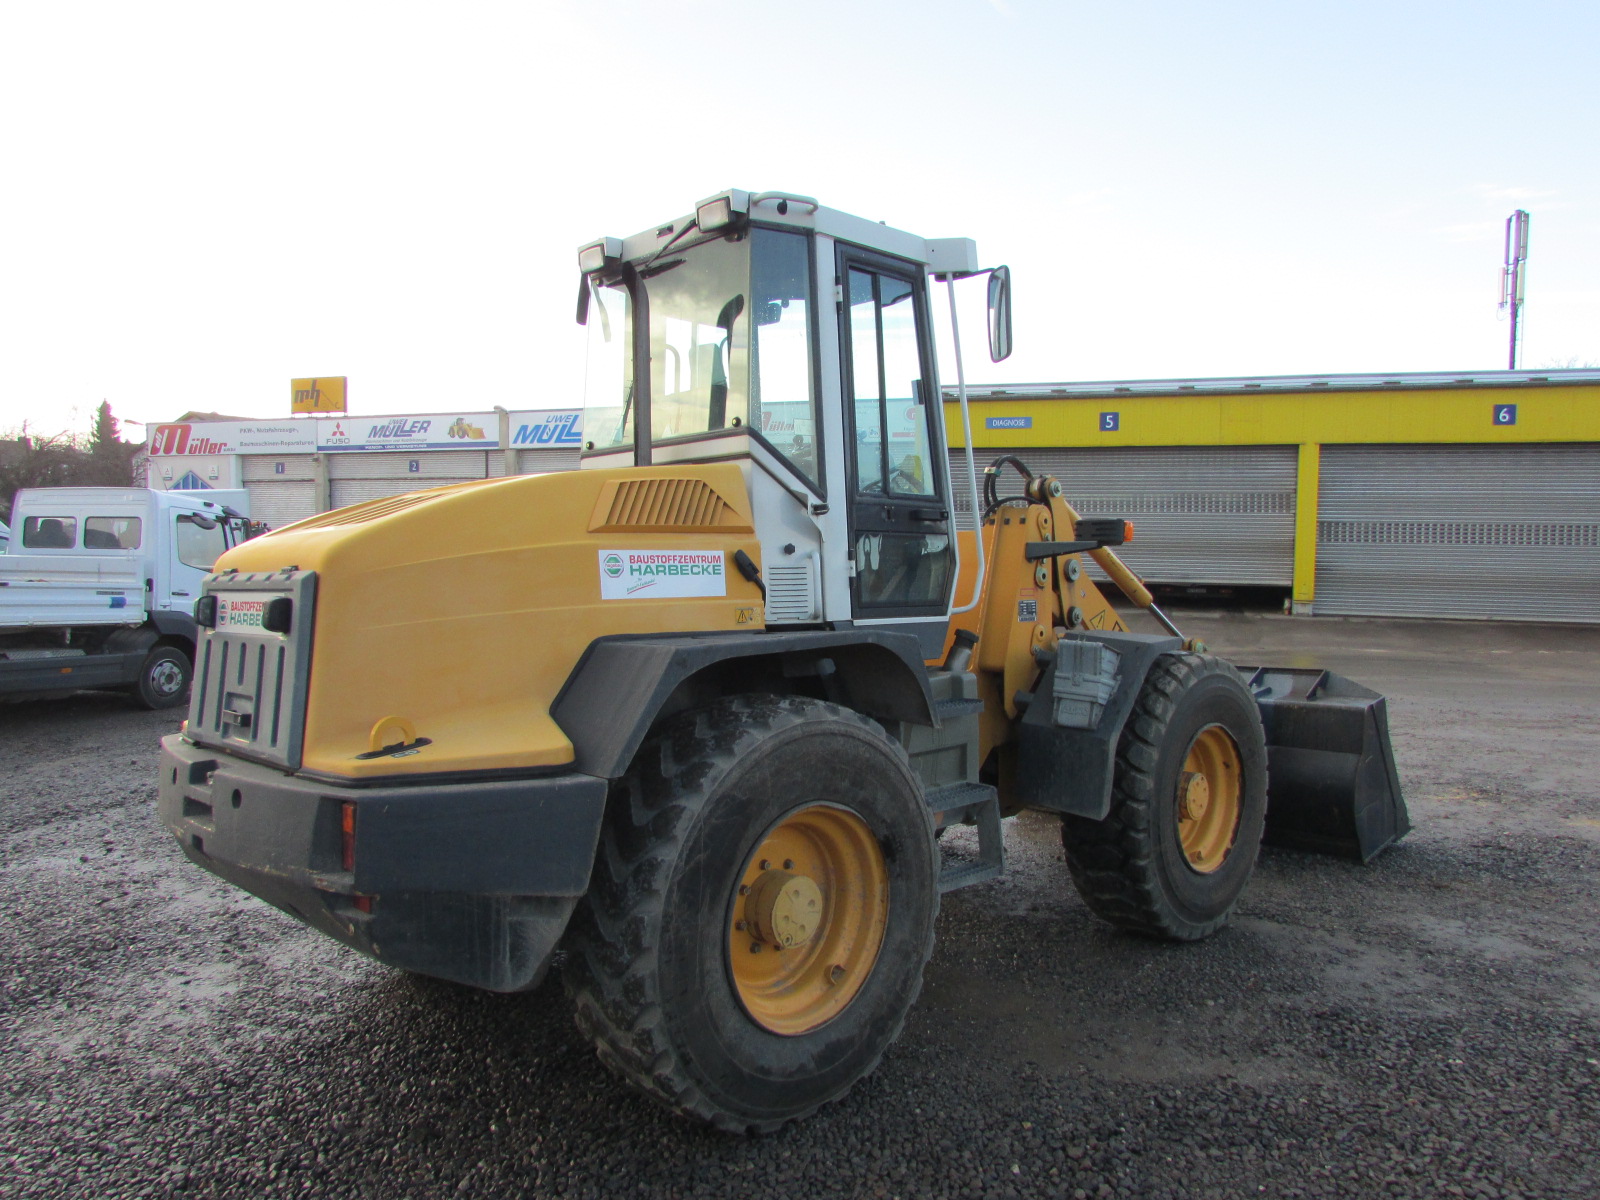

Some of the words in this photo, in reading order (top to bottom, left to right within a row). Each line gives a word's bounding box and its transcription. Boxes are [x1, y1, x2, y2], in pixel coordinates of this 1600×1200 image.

[546, 414, 573, 424] UWE
[1499, 407, 1509, 422] 6
[992, 419, 1025, 427] DIAGNOSE
[1105, 416, 1114, 428] 5
[512, 414, 582, 444] MÜLL
[150, 424, 228, 455] Müller
[325, 437, 350, 445] FUSO
[410, 461, 417, 472] 2
[629, 554, 721, 564] BAUSTOFFZENTRUM
[629, 564, 722, 576] HARBECKE
[231, 601, 264, 612] BAUSTOFFZE
[230, 612, 261, 626] HARBE
